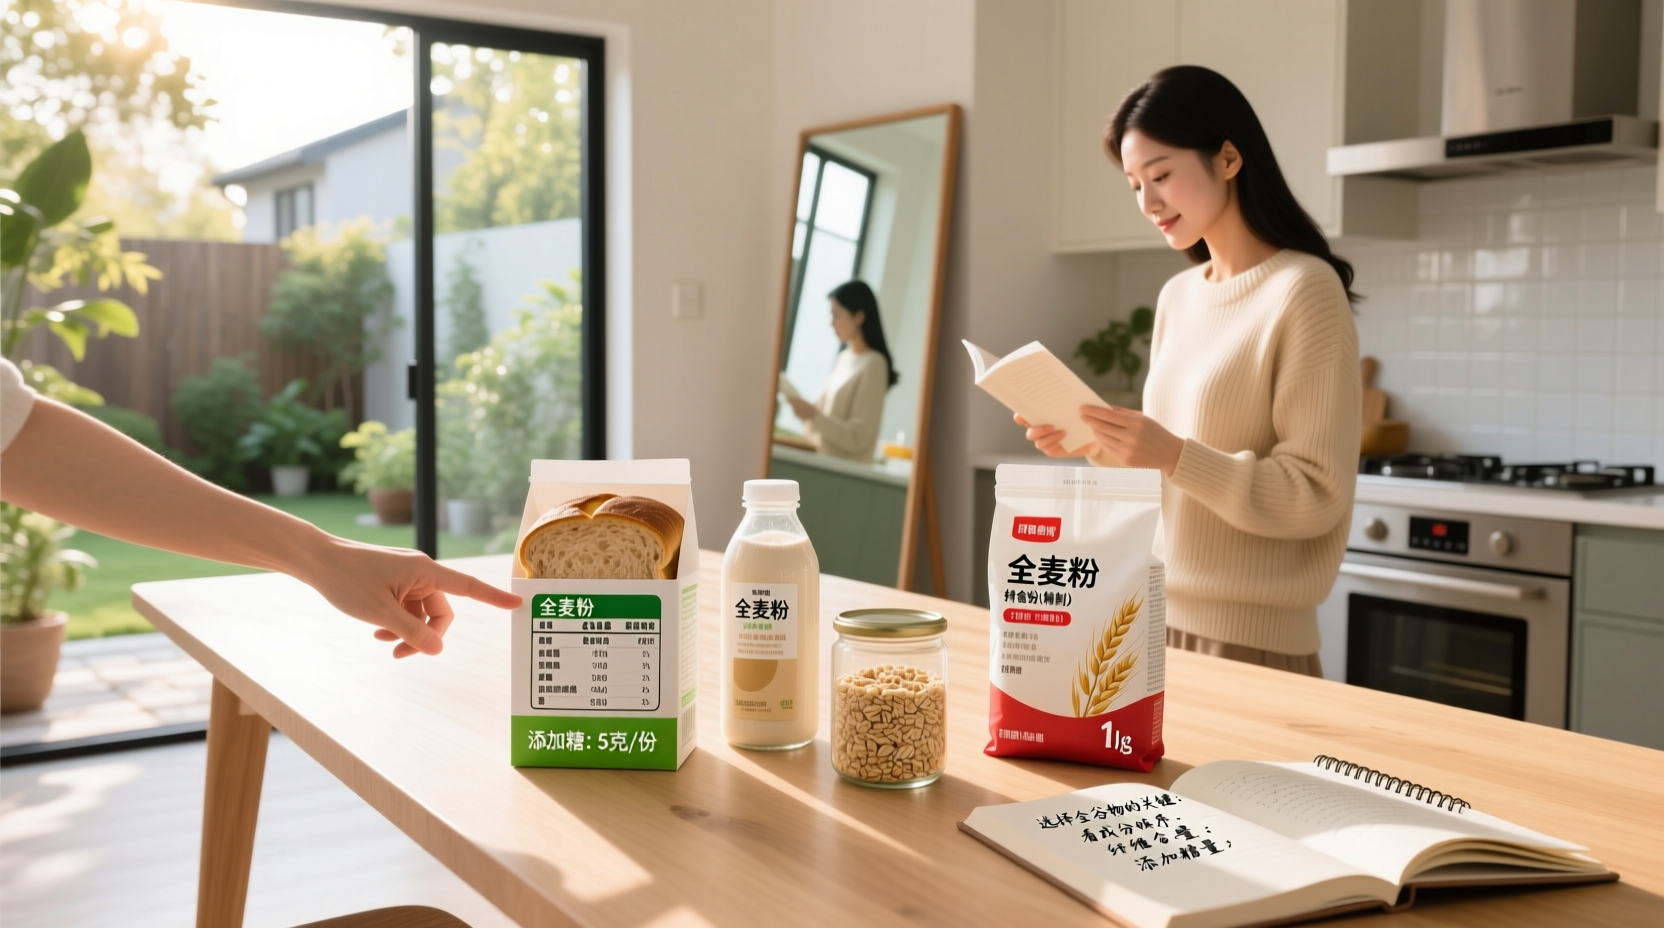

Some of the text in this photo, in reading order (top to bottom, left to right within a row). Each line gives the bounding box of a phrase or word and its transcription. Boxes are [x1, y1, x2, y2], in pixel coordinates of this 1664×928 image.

[1007, 554, 1100, 589] 全麦粉
[539, 596, 595, 618] 全麦粉
[735, 598, 790, 621] 全麦粉
